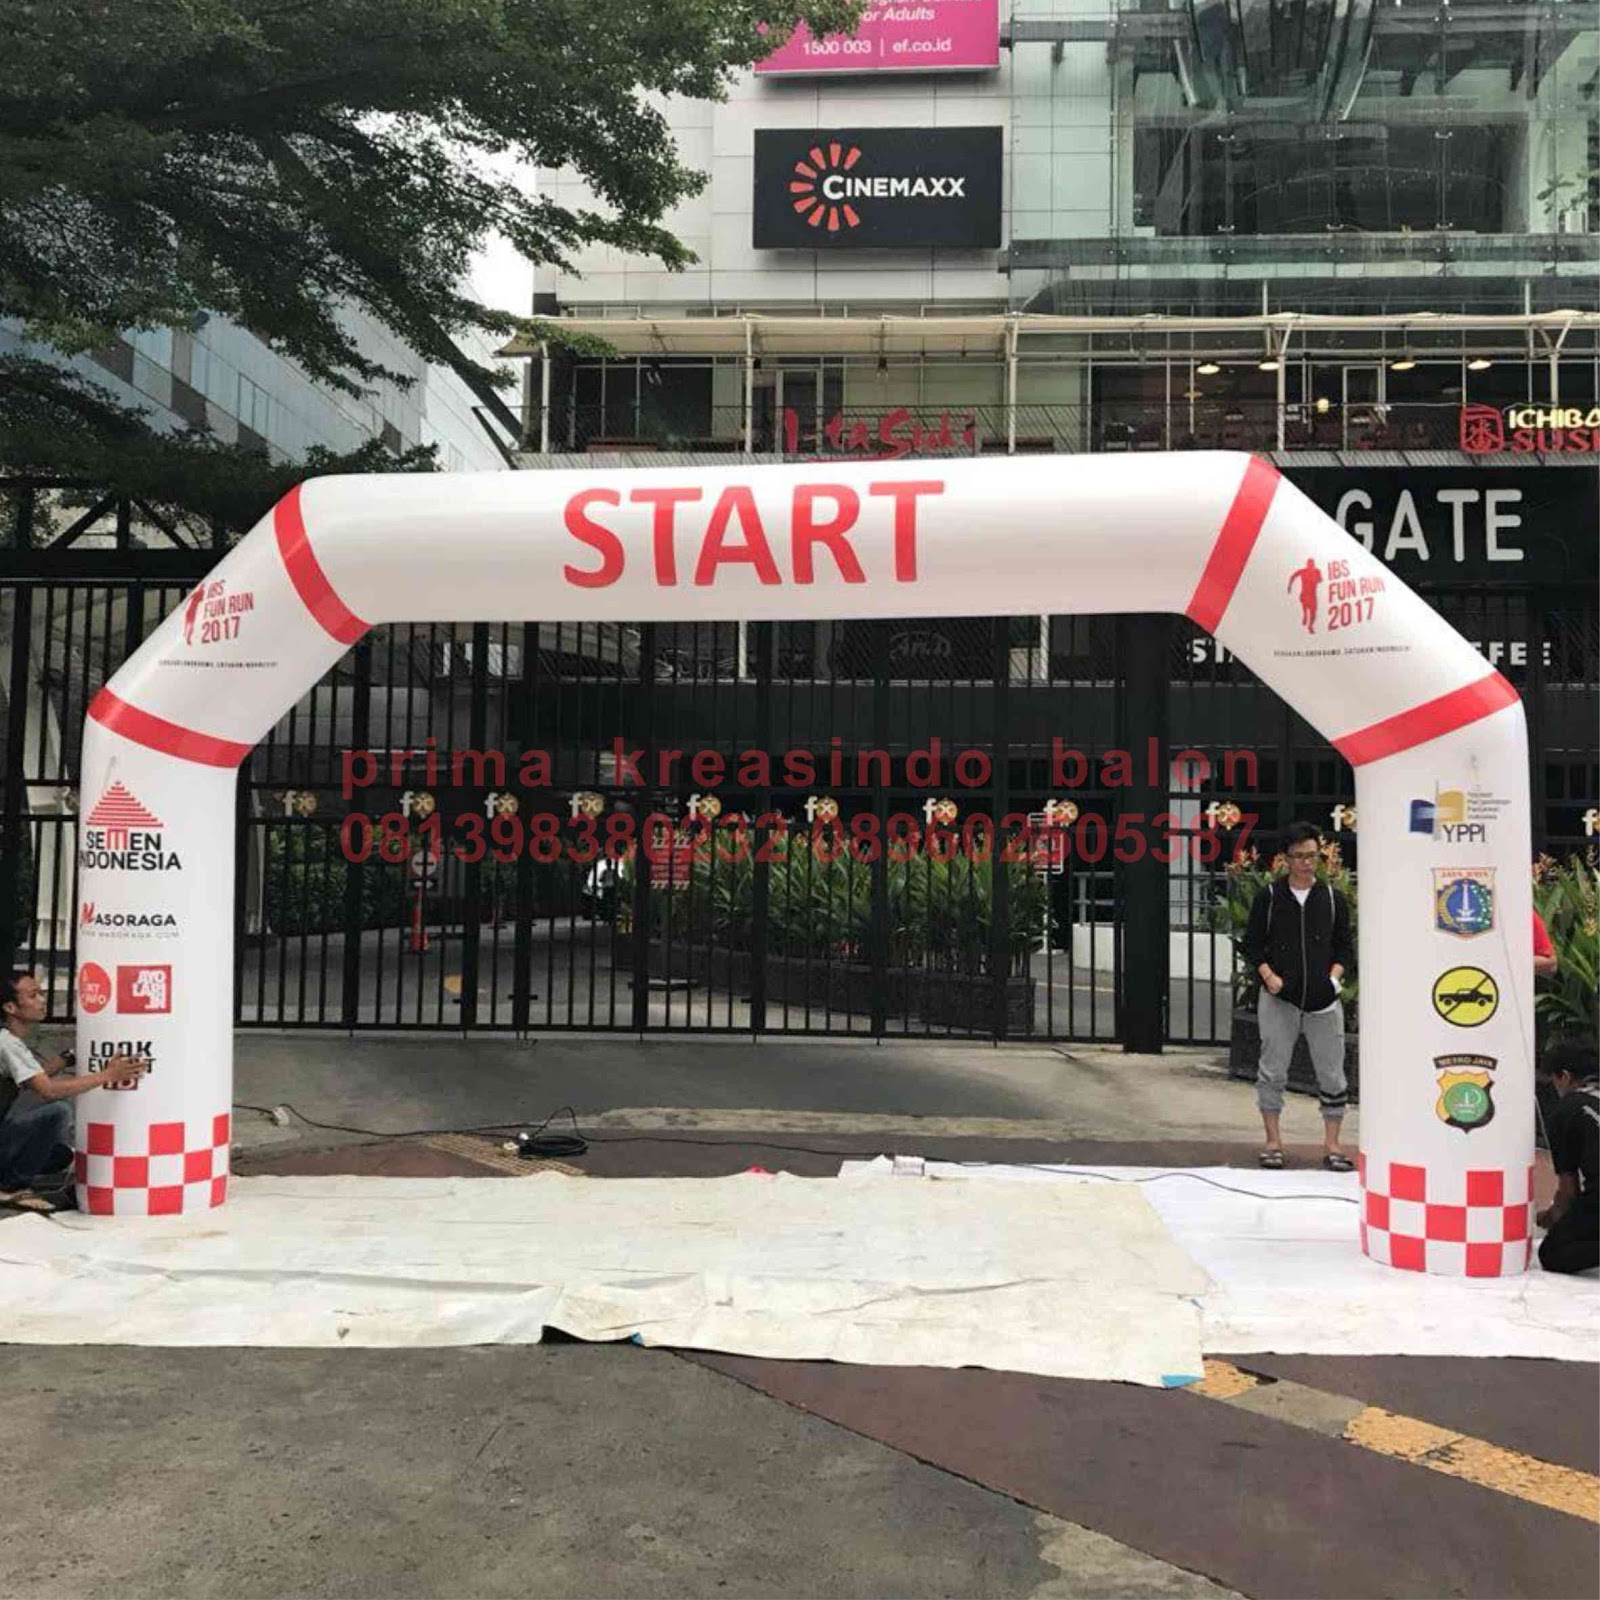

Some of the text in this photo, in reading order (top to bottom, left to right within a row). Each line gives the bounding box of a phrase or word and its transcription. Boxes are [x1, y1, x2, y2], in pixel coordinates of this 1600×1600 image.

[883, 7, 936, 21] Adults
[804, 38, 952, 55] 1500 003 ef.co.id
[822, 174, 966, 200] CINEMAXX
[563, 480, 945, 589] START
[1336, 488, 1525, 562] GATE
[1327, 559, 1350, 580] IBS
[1328, 576, 1385, 603] FUN RUN
[203, 592, 254, 618] FUN RUN
[1327, 597, 1374, 631] 2017
[201, 616, 240, 643] 2017
[86, 828, 162, 851] SEMEN
[1442, 823, 1486, 843] YPPI
[90, 1040, 152, 1058] LOOK
[88, 1057, 157, 1074] EVT
